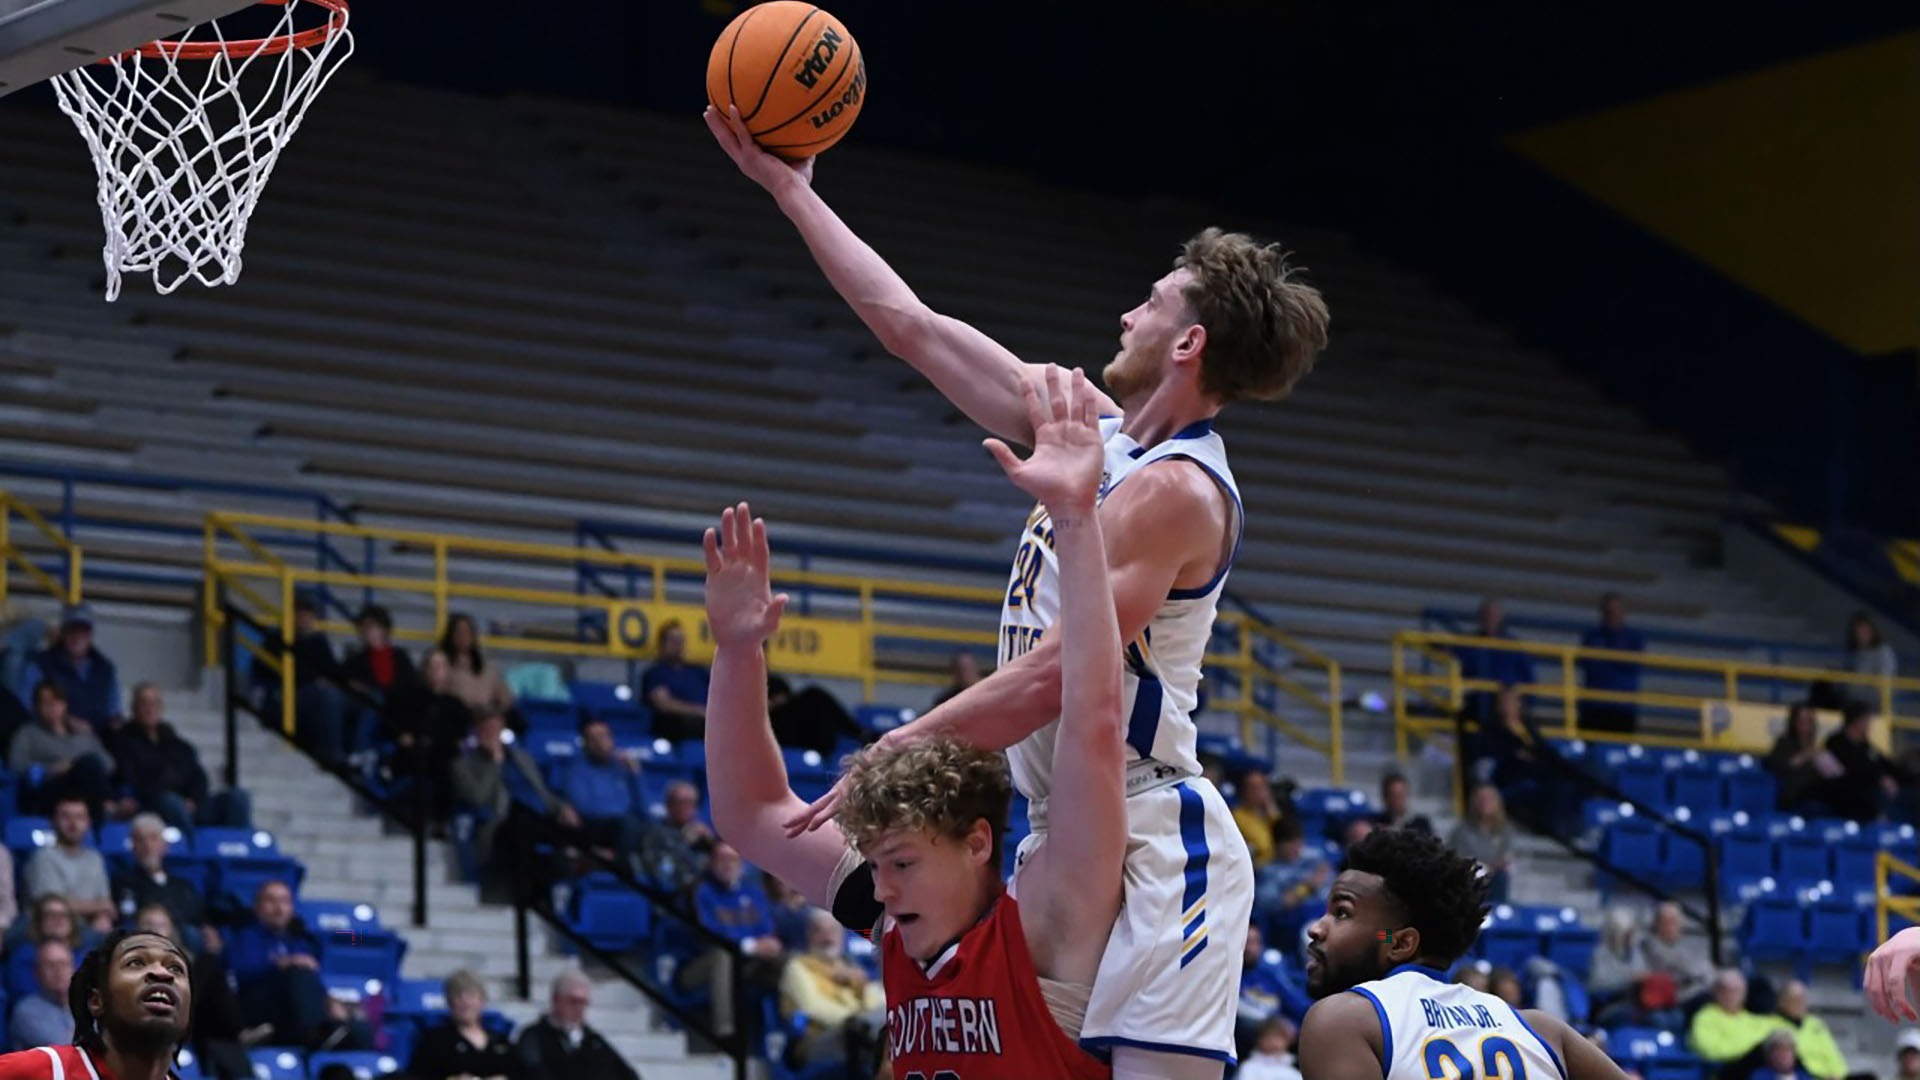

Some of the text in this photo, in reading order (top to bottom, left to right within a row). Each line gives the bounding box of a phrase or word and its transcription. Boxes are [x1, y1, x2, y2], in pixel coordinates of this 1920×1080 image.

[795, 26, 842, 89] NCAA
[1419, 998, 1502, 1029] BRYAN JR.
